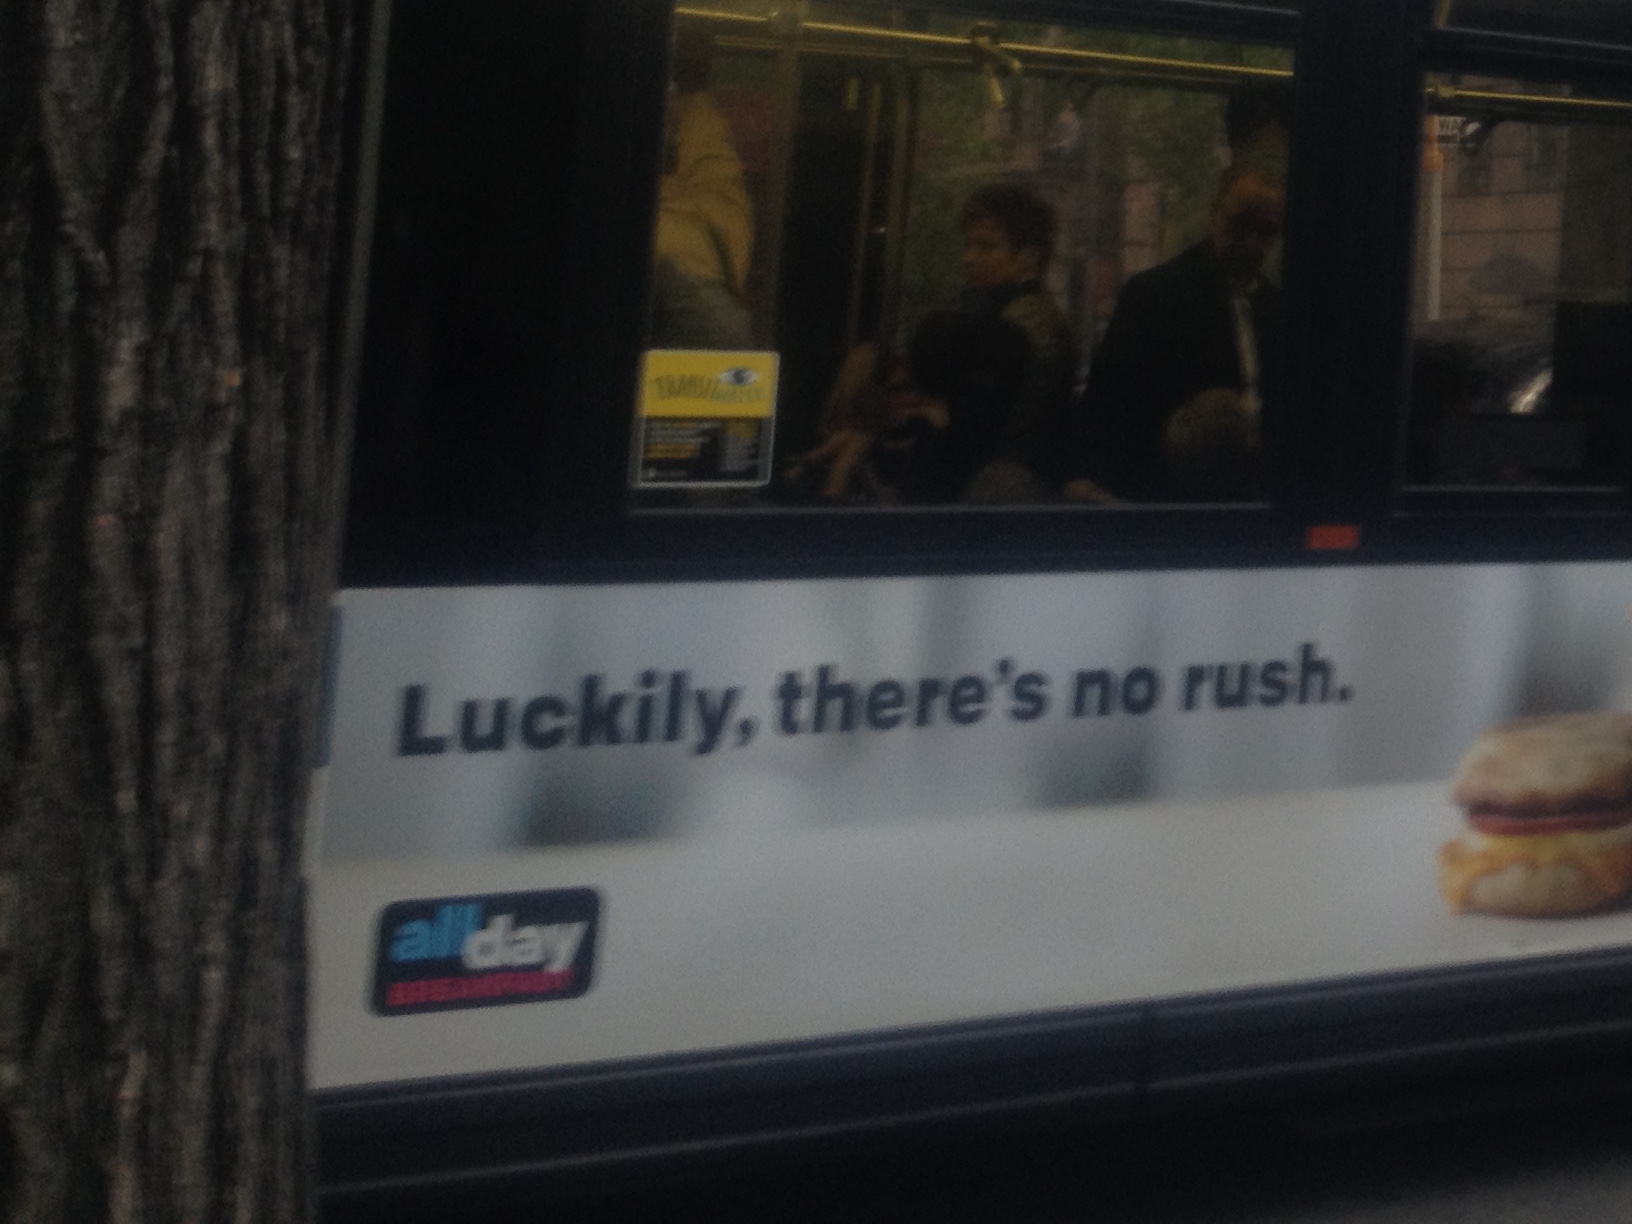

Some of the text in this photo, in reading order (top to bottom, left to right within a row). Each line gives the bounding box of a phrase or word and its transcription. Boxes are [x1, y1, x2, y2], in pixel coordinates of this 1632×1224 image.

[398, 641, 1354, 756] Luckily, there's no rush.
[460, 912, 591, 973] day
